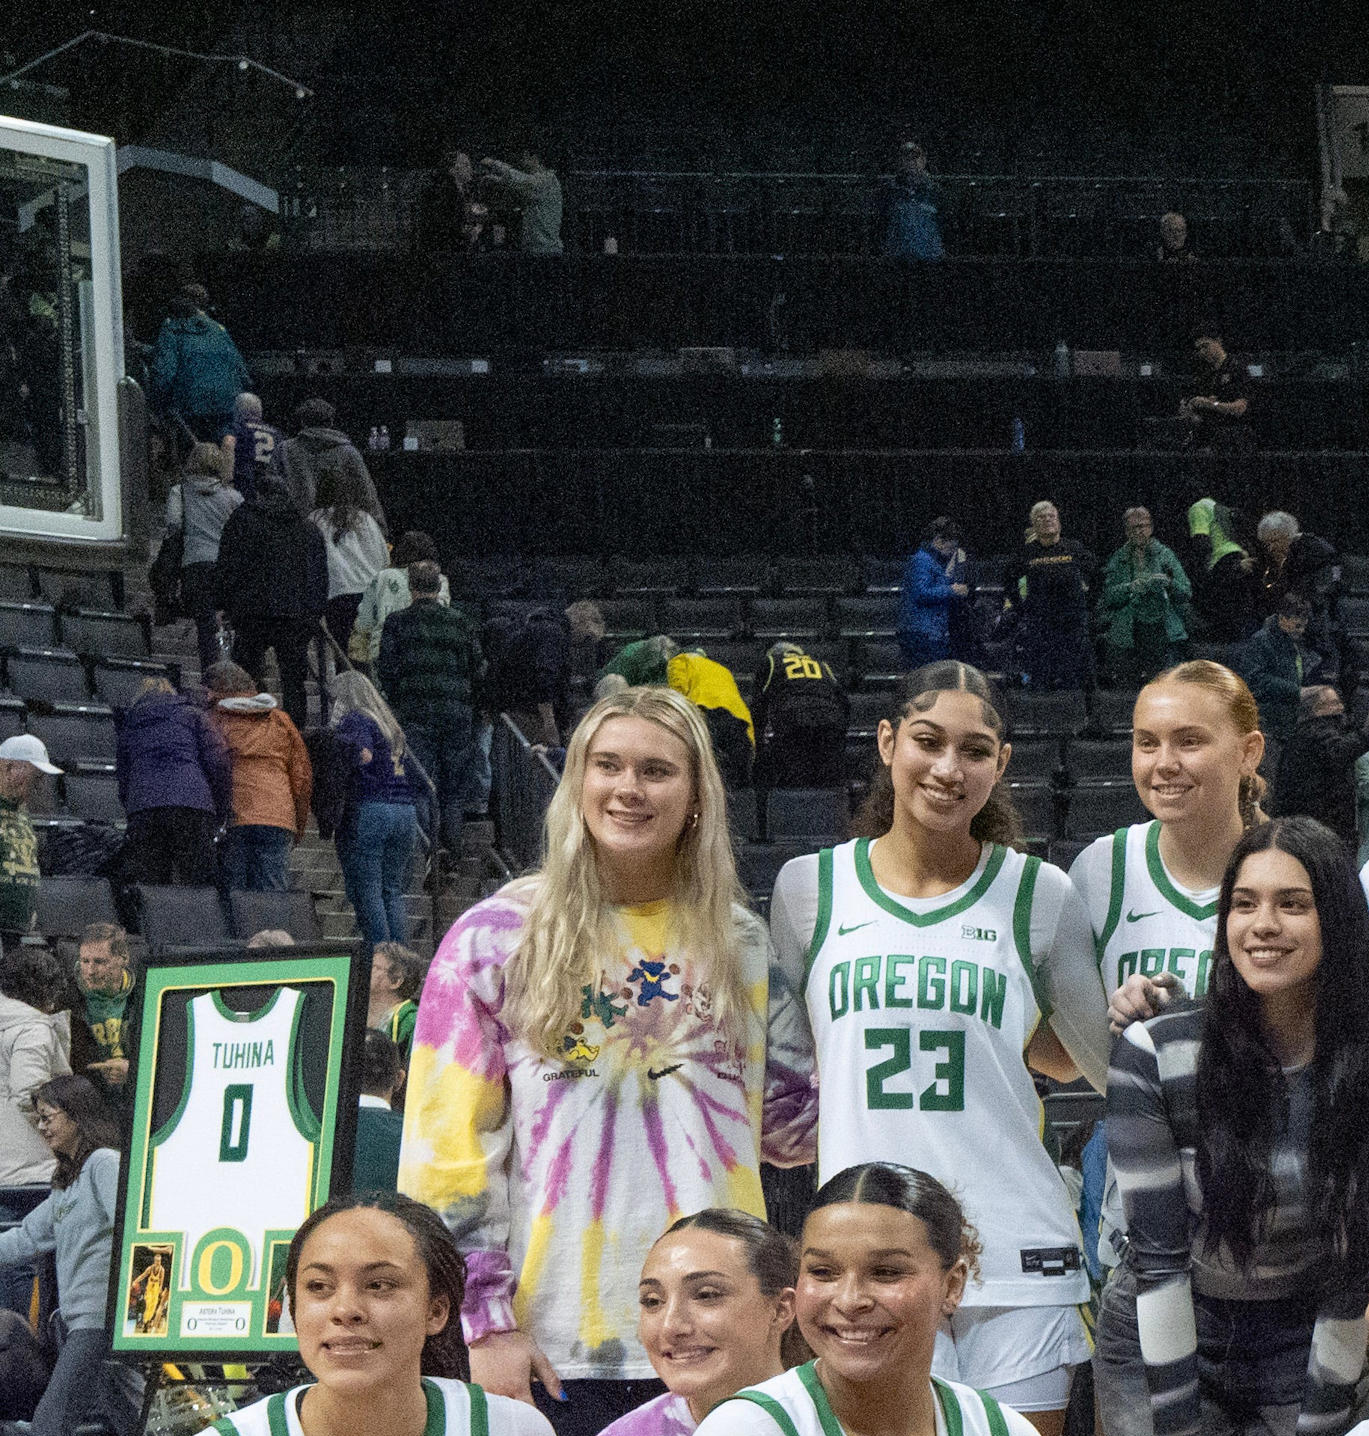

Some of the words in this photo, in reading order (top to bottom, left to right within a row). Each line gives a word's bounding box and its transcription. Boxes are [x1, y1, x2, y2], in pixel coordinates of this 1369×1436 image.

[783, 656, 822, 679] 20
[829, 954, 1007, 1030] OREGON
[212, 1040, 274, 1069] TUHINA
[543, 1068, 599, 1082] GRATEFUL
[864, 1028, 966, 1112] 23
[219, 1083, 254, 1162] 0
